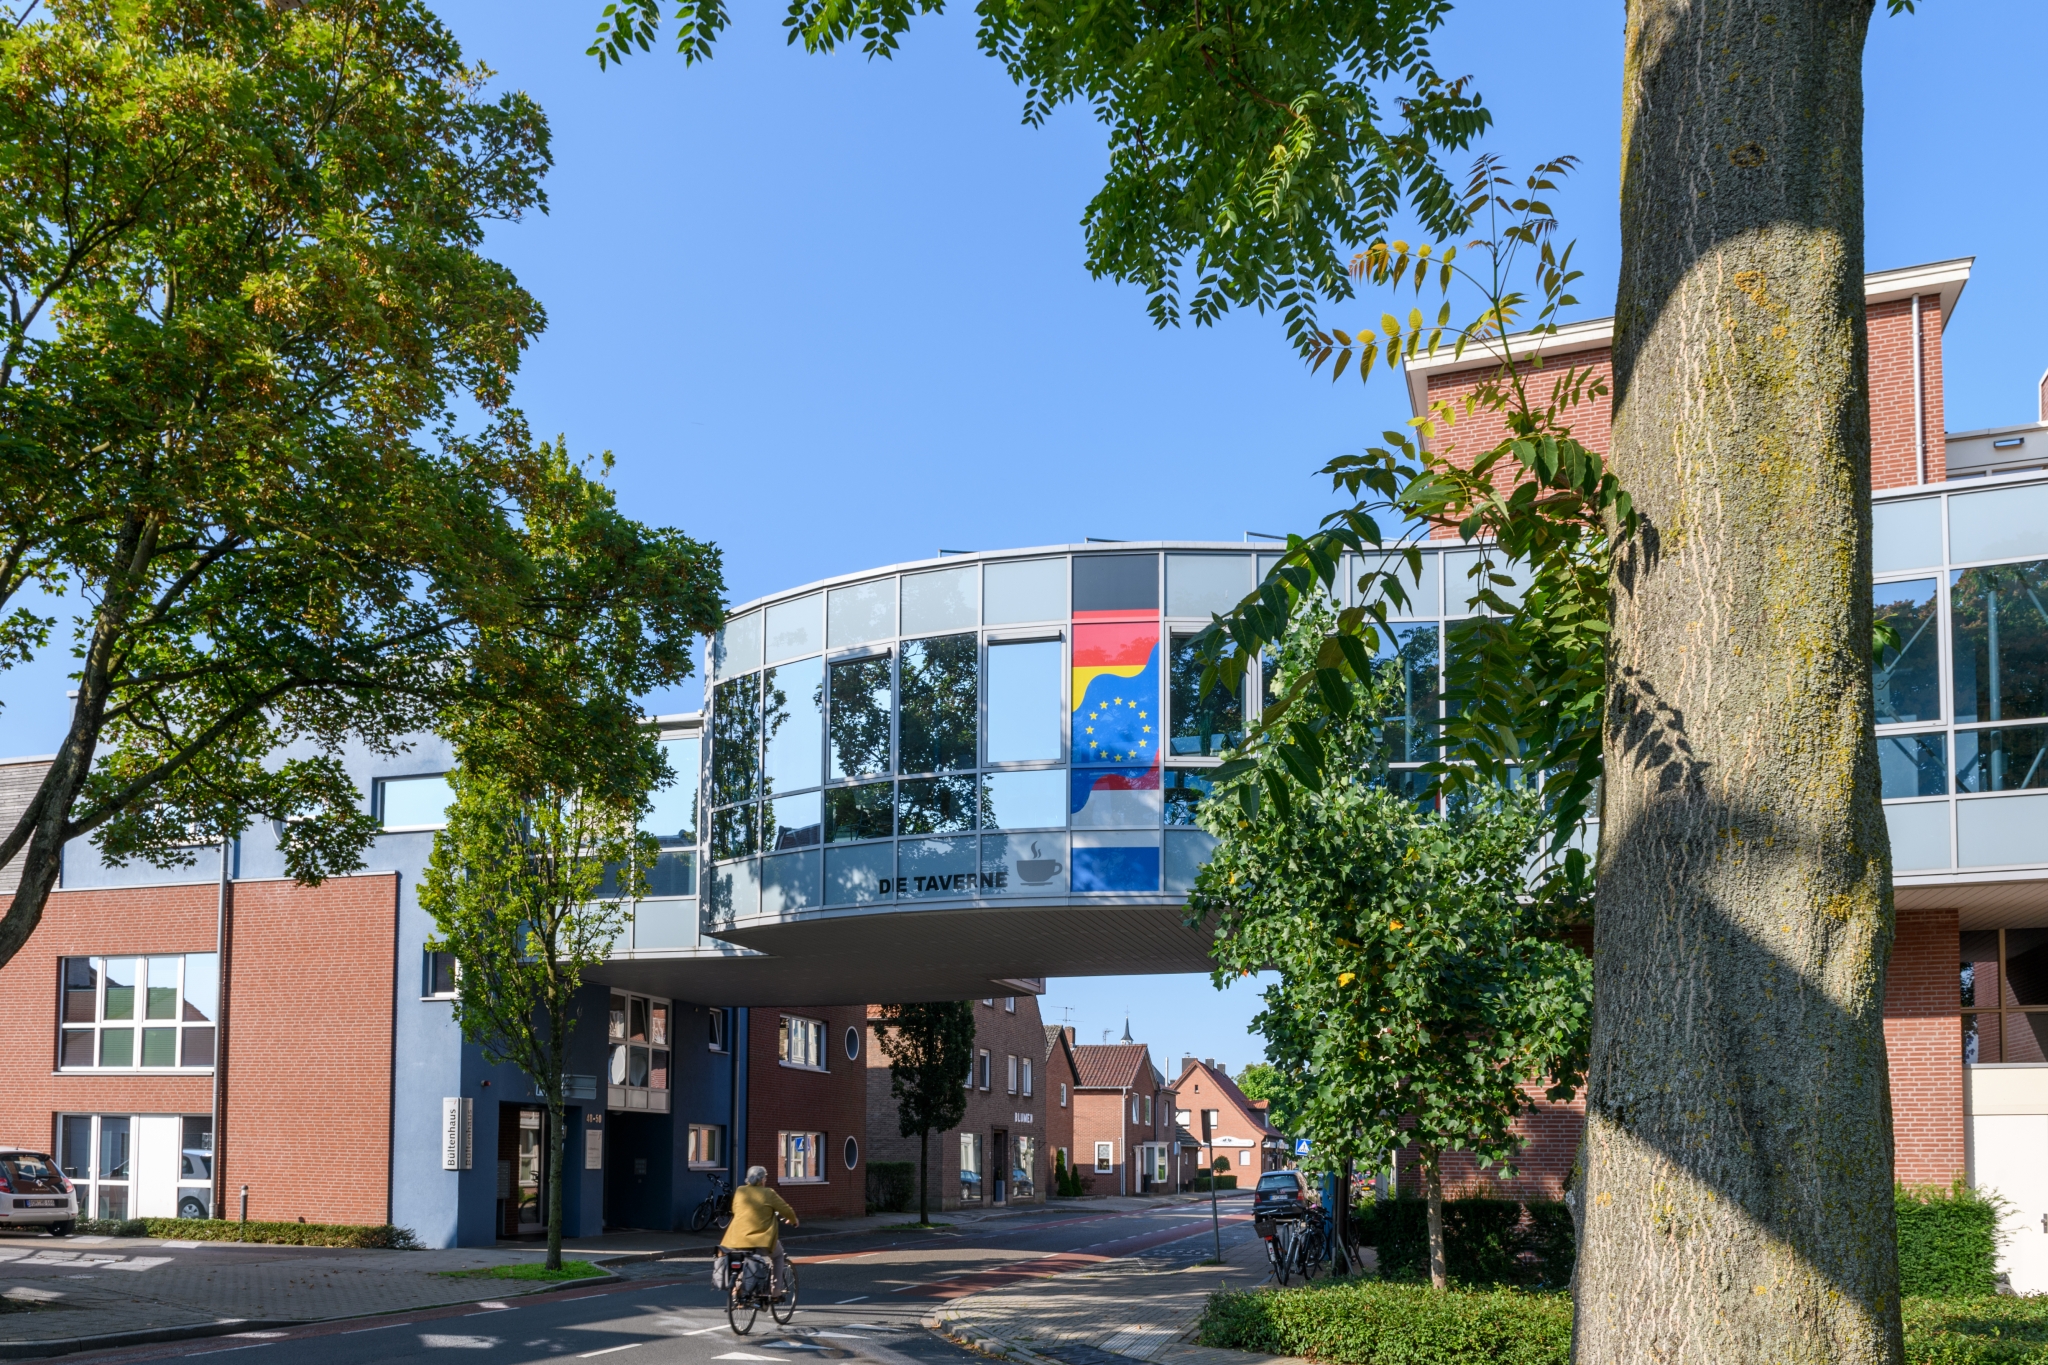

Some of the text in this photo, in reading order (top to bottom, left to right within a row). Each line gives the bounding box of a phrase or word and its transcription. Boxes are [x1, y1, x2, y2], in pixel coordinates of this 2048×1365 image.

[879, 871, 1008, 894] DIE TAVERNE
[447, 1108, 457, 1166] Bültenhaus
